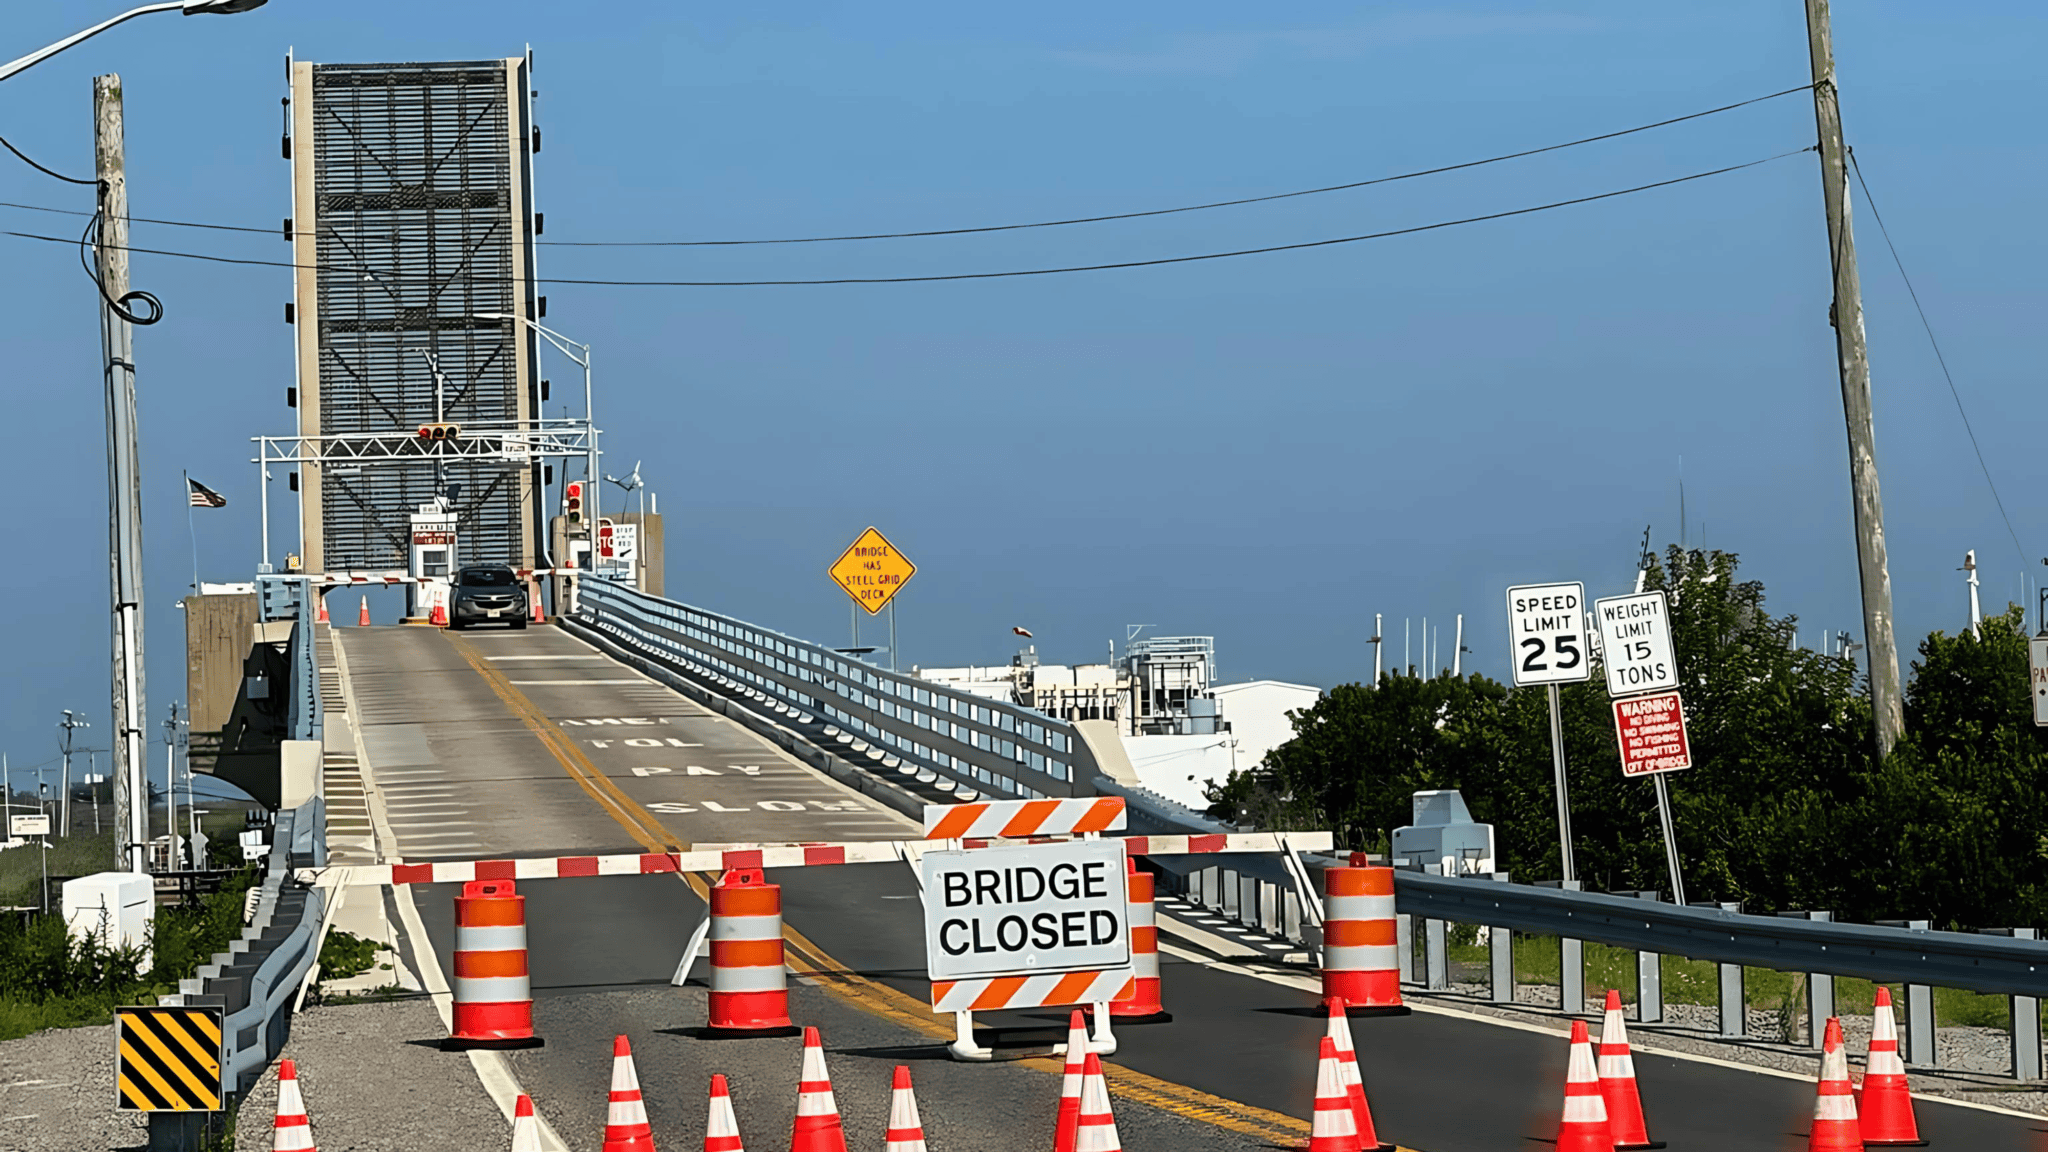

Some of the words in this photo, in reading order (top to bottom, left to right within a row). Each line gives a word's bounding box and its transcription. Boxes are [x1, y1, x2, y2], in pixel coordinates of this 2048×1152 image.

[855, 546, 888, 557] BRIDGE
[863, 560, 881, 571] HAS
[846, 575, 875, 586] STEEL
[878, 574, 900, 585] GRID
[861, 589, 885, 600] DECK
[1516, 595, 1577, 613] SPEED
[1604, 601, 1658, 621] WEIGHT
[1523, 615, 1571, 632] LIMIT
[1615, 621, 1653, 639] LIMIT
[1520, 635, 1580, 672] 25
[1624, 641, 1652, 661] 15
[1617, 663, 1666, 686] TONS
[1620, 697, 1675, 717] WARNING
[631, 765, 760, 777] PAY
[944, 862, 1107, 907] BRIDGE
[940, 910, 1118, 956] CLOSED
